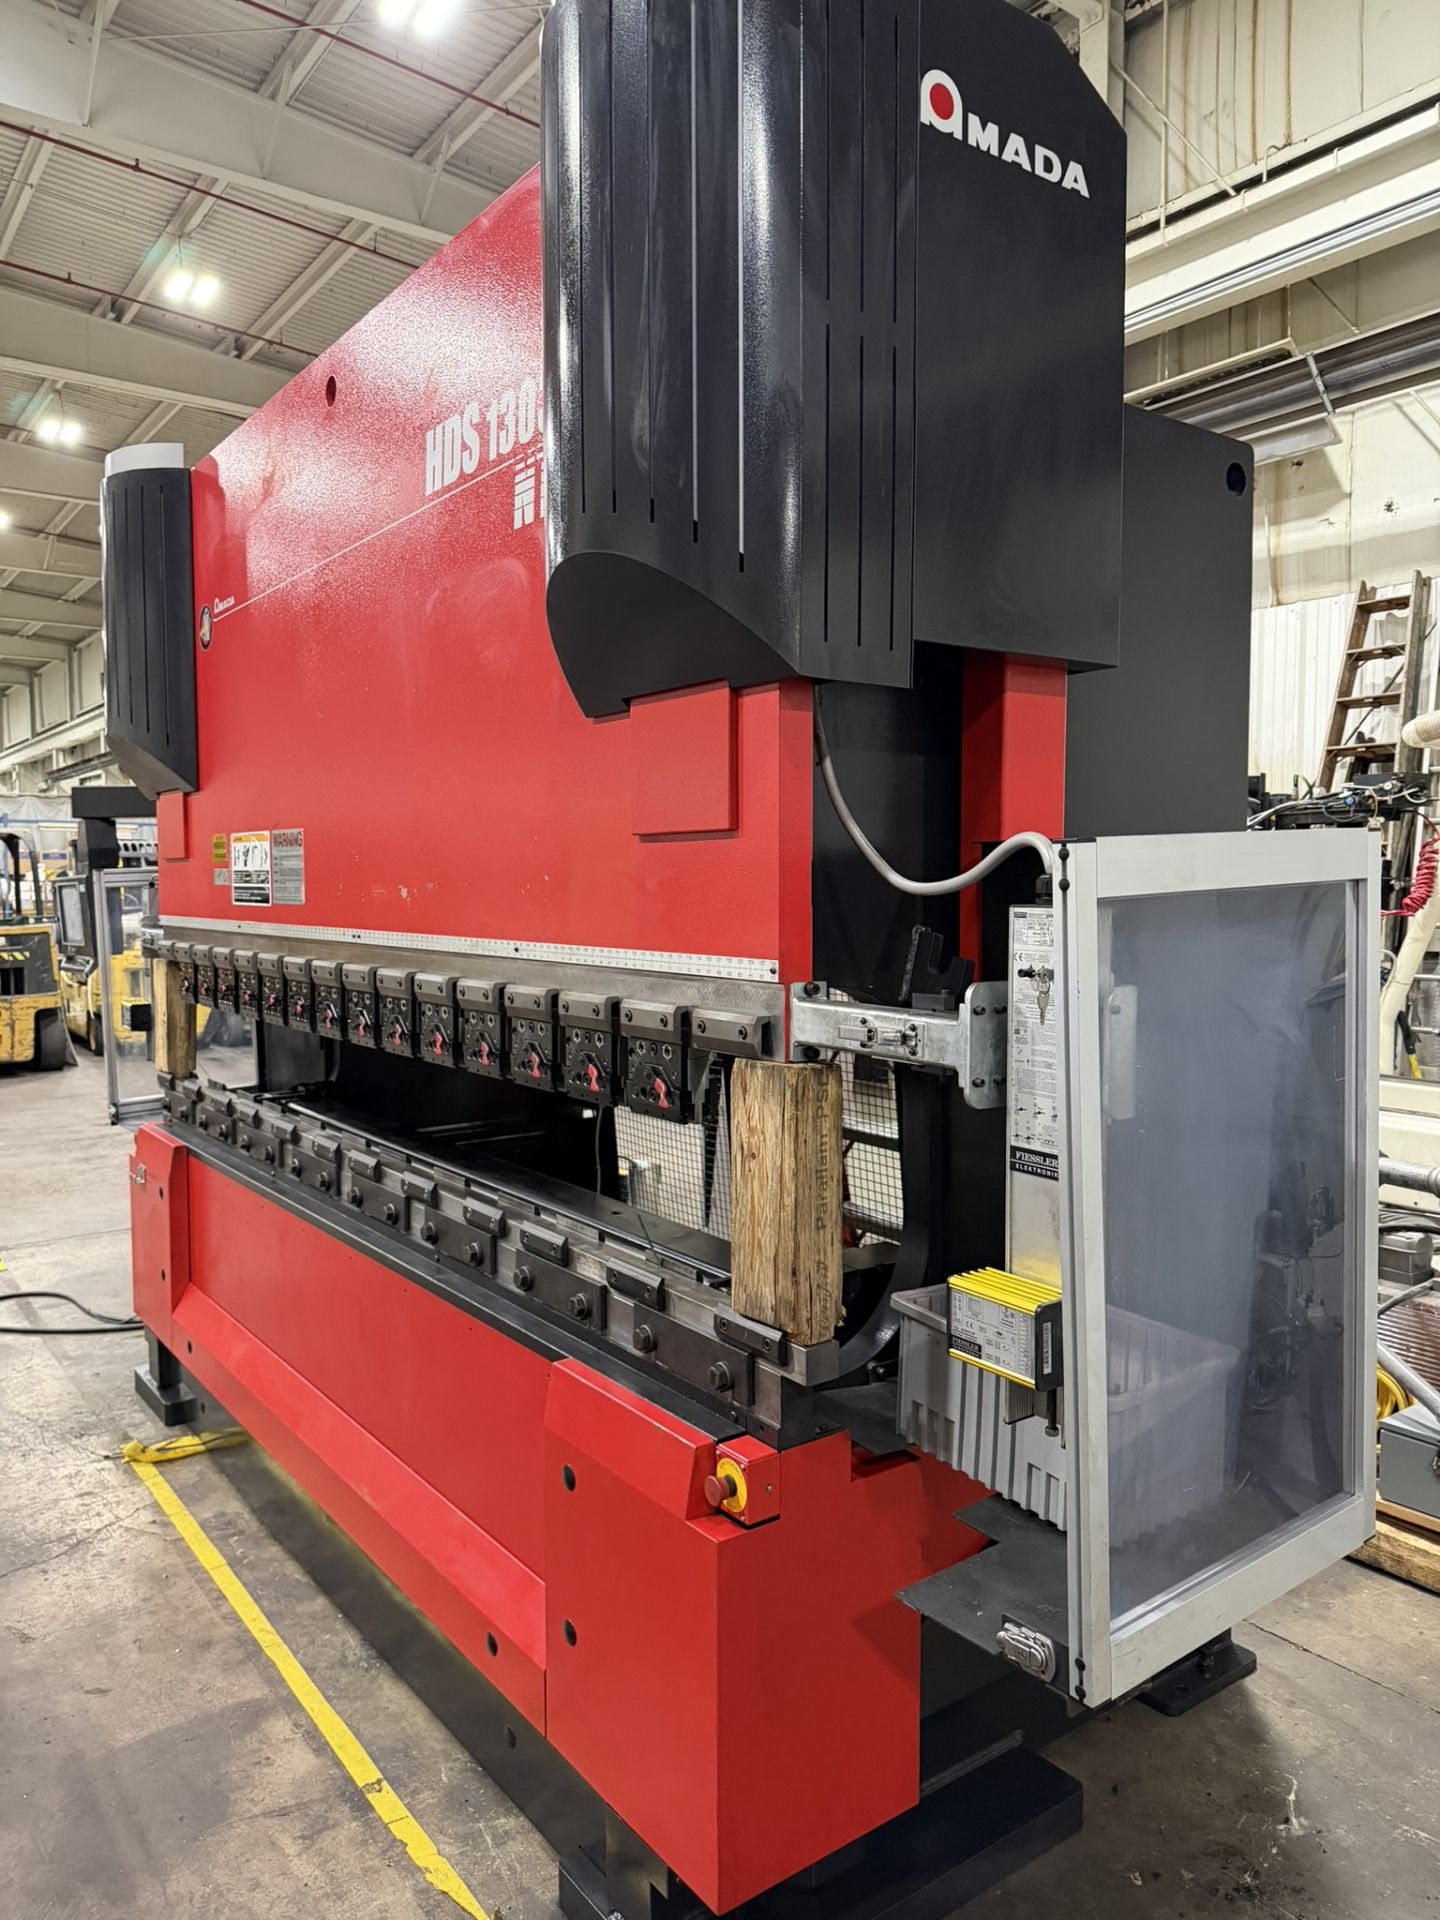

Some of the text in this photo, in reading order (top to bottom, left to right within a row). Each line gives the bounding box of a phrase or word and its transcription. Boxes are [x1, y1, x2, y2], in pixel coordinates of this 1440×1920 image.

[920, 69, 1090, 198] AMADA
[425, 378, 544, 497] HDS 130
[272, 831, 303, 848] WARNING
[1015, 1150, 1058, 1168] FIESSLER
[1015, 1163, 1058, 1178] ELEKTRONIK
